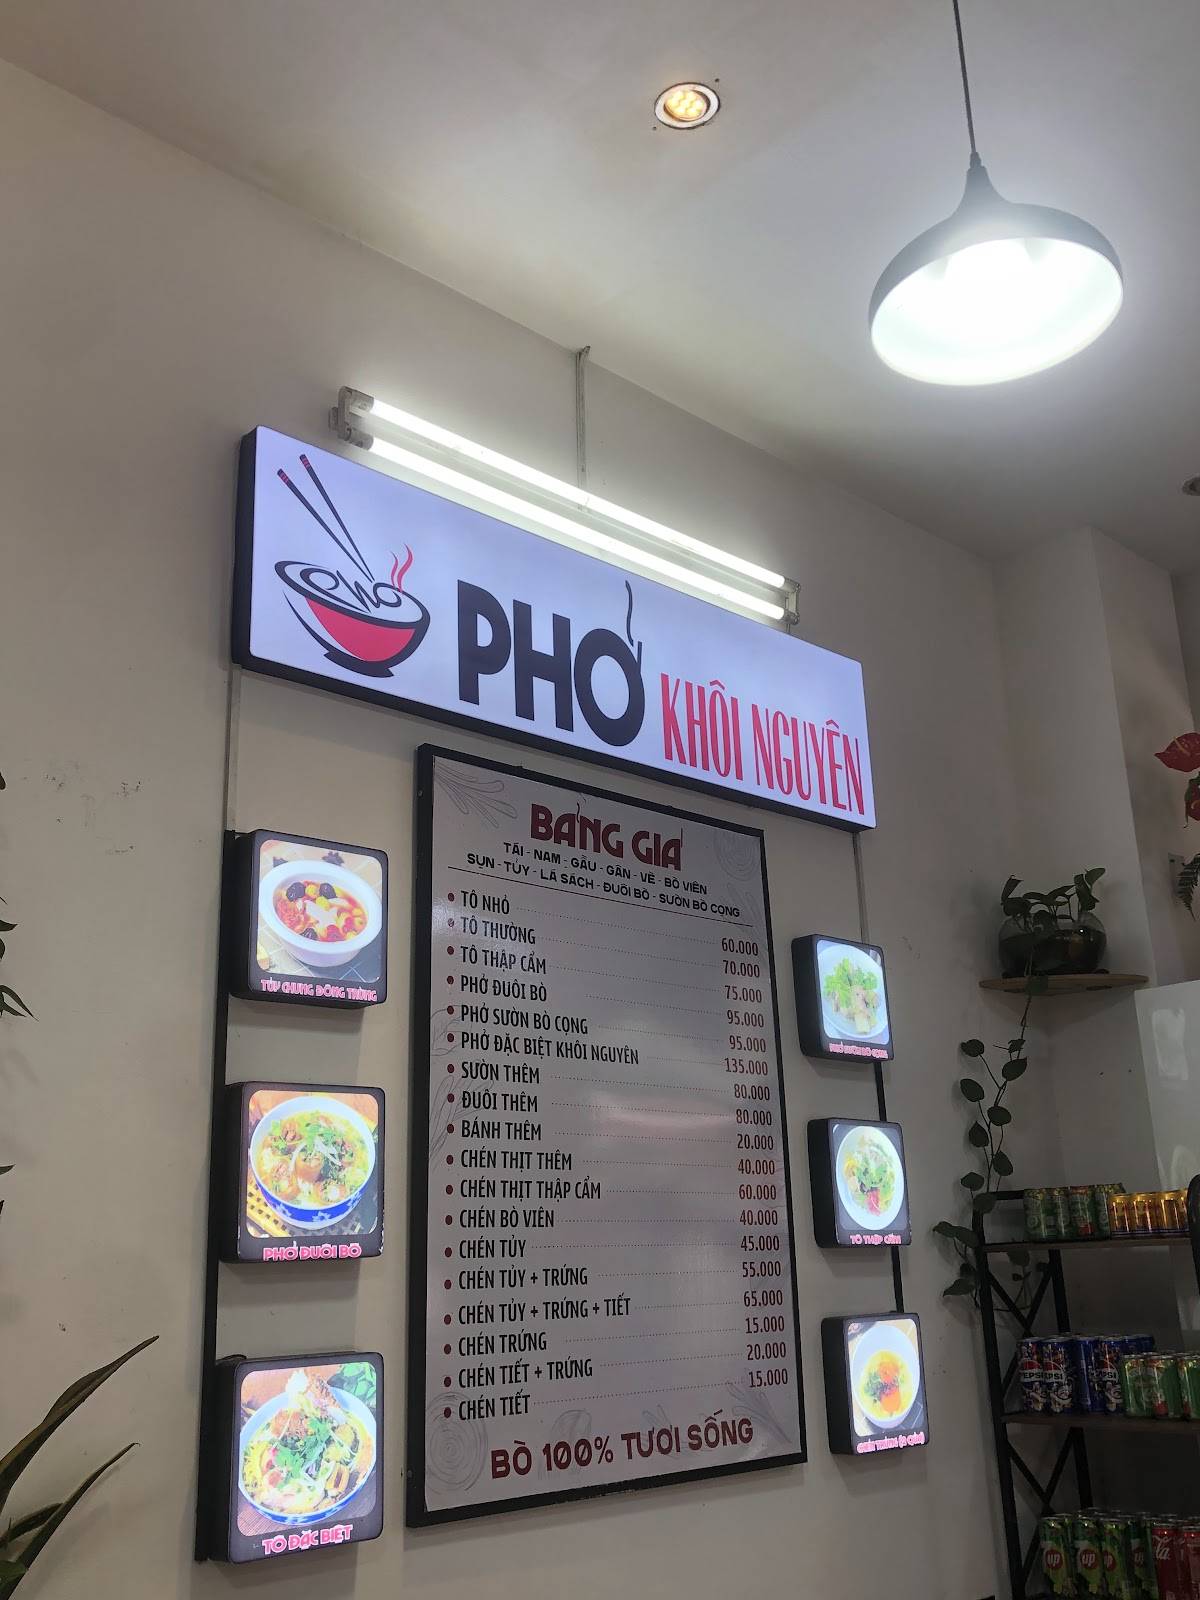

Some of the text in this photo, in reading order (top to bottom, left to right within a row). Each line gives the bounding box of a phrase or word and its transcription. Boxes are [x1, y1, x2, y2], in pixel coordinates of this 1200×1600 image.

[457, 579, 865, 815] PHỞ KHÔI NGUYÊN
[682, 880, 708, 895] VIÊN
[460, 889, 759, 956] TÔ NHỎ 60.000
[460, 915, 760, 978] TÔ THƯỜNG 70.000
[460, 944, 478, 964] TÔ
[482, 949, 516, 972] THẬP
[725, 985, 762, 1003] 75.000
[460, 973, 764, 1028] PHỞ ĐUÔI BÒ 95.000
[460, 1002, 766, 1052] PHỞ SƯỜN BÒ CỌNG 95.000
[461, 1029, 768, 1076] PHỞ ĐẶC BIỆT KHÔI NGUYÊN 135.000
[461, 1059, 770, 1100] SƯỜN THÊM 80.000
[461, 1089, 772, 1126] ĐUÔI THÊM 80.000
[461, 1116, 774, 1150] BÁNH THÊM 20.000
[460, 1146, 775, 1175] CHÉN THỊT THÊM 40.000
[460, 1175, 496, 1198] CHÉN
[500, 1180, 532, 1202] THỊT
[536, 1178, 571, 1202] THẬP
[739, 1184, 777, 1200] 60.000
[459, 1205, 778, 1228] CHÉN BÒ VIÊN 40.000
[263, 1240, 362, 1260] PHỞ ĐUÔI BÒ
[459, 1235, 780, 1258] CHÉN TỦY 45.000
[458, 1266, 494, 1290] CHÉN
[499, 1264, 526, 1288] TỦY
[543, 1264, 588, 1286] TRỨNG
[742, 1261, 781, 1278] 55.000
[458, 1300, 494, 1325] CHÉN
[499, 1298, 526, 1322] TỦY
[543, 1297, 588, 1320] TRỨNG
[604, 1292, 631, 1317] TIẾT
[743, 1289, 783, 1307] 65.000
[458, 1316, 784, 1356] CHÉN TRỨNG 15.000
[458, 1363, 495, 1388] CHÉN
[500, 1358, 529, 1385] TIẾT
[547, 1356, 593, 1380] TRỨNG
[747, 1341, 786, 1361] 20.000
[459, 1368, 788, 1421] CHÉN TIẾT 15.000
[490, 1409, 754, 1479] BÒ 100% TƯƠI SỐNG
[262, 1524, 353, 1555] TÔ ĐẶC BIỆT
